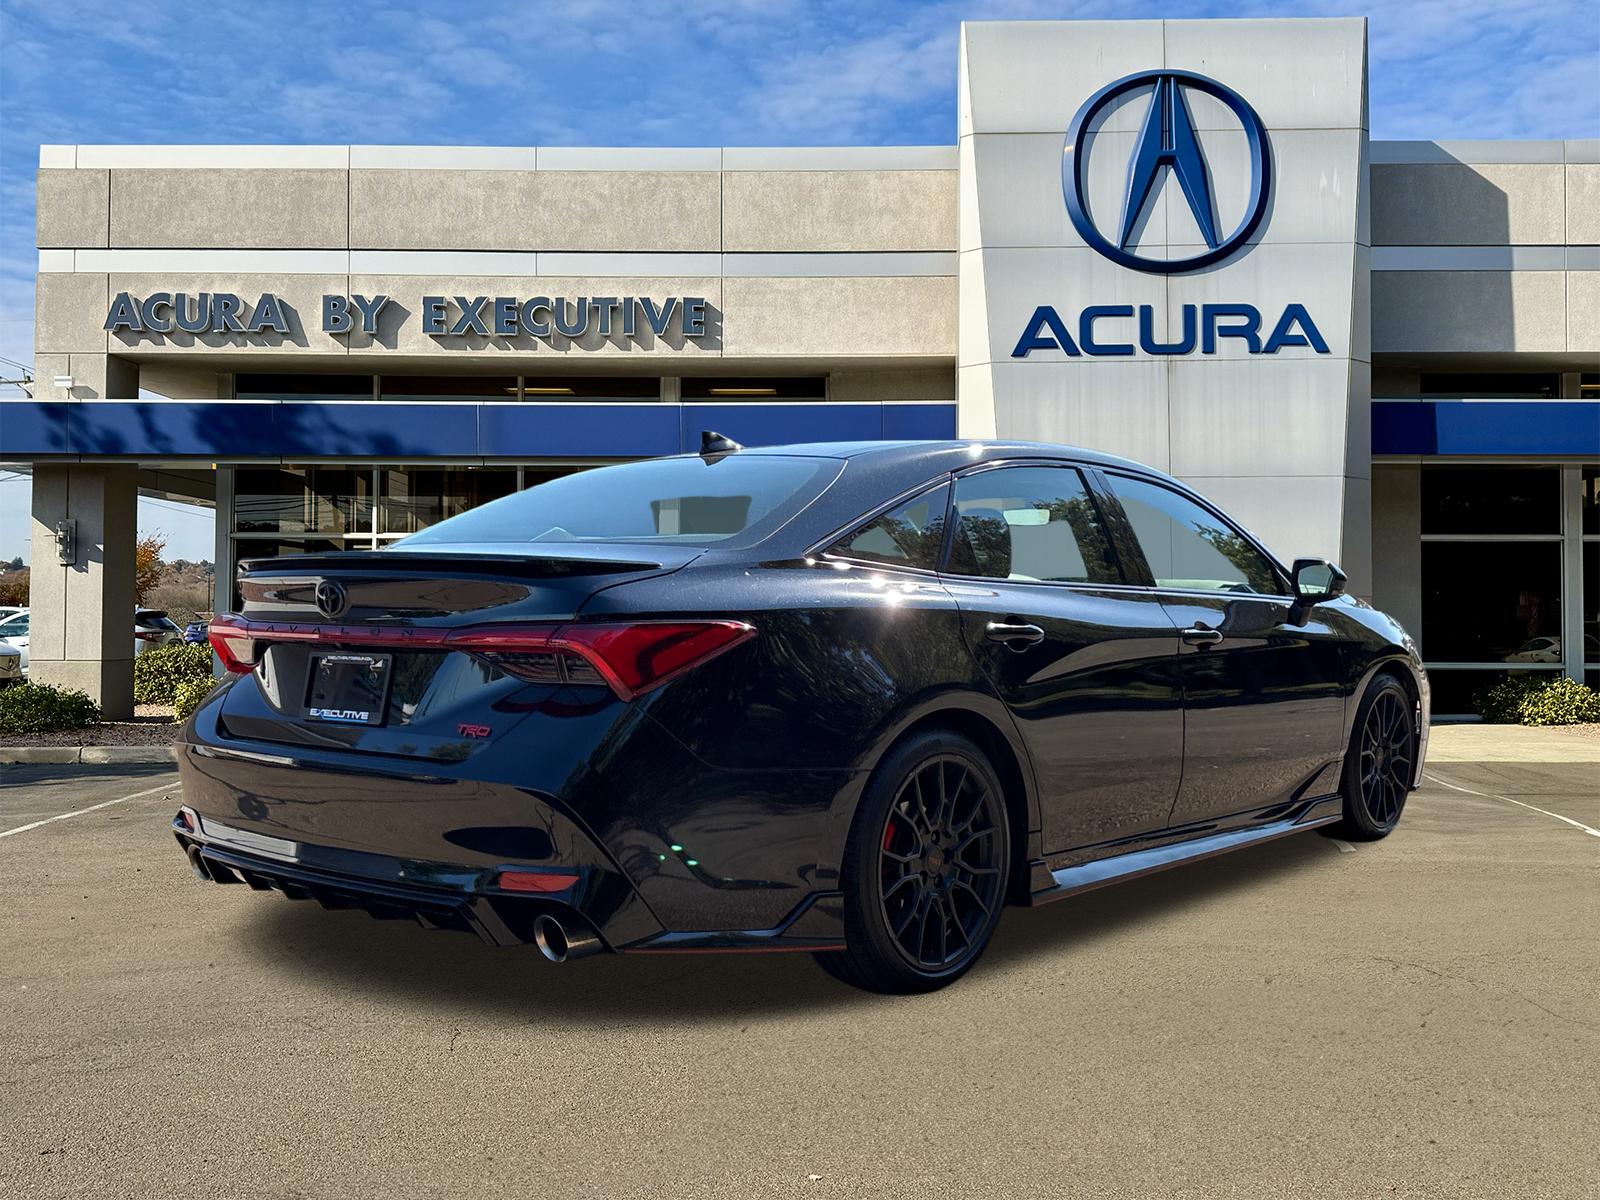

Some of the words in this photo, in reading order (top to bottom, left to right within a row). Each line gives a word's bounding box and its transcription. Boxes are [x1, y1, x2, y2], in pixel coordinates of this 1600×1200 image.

[103, 292, 291, 333] ACURA
[322, 294, 391, 334] BY
[422, 296, 706, 337] EXECUTIVE
[1011, 303, 1331, 357] ACURA
[310, 708, 369, 720] EXECUTIVE
[457, 723, 490, 737] TRD
